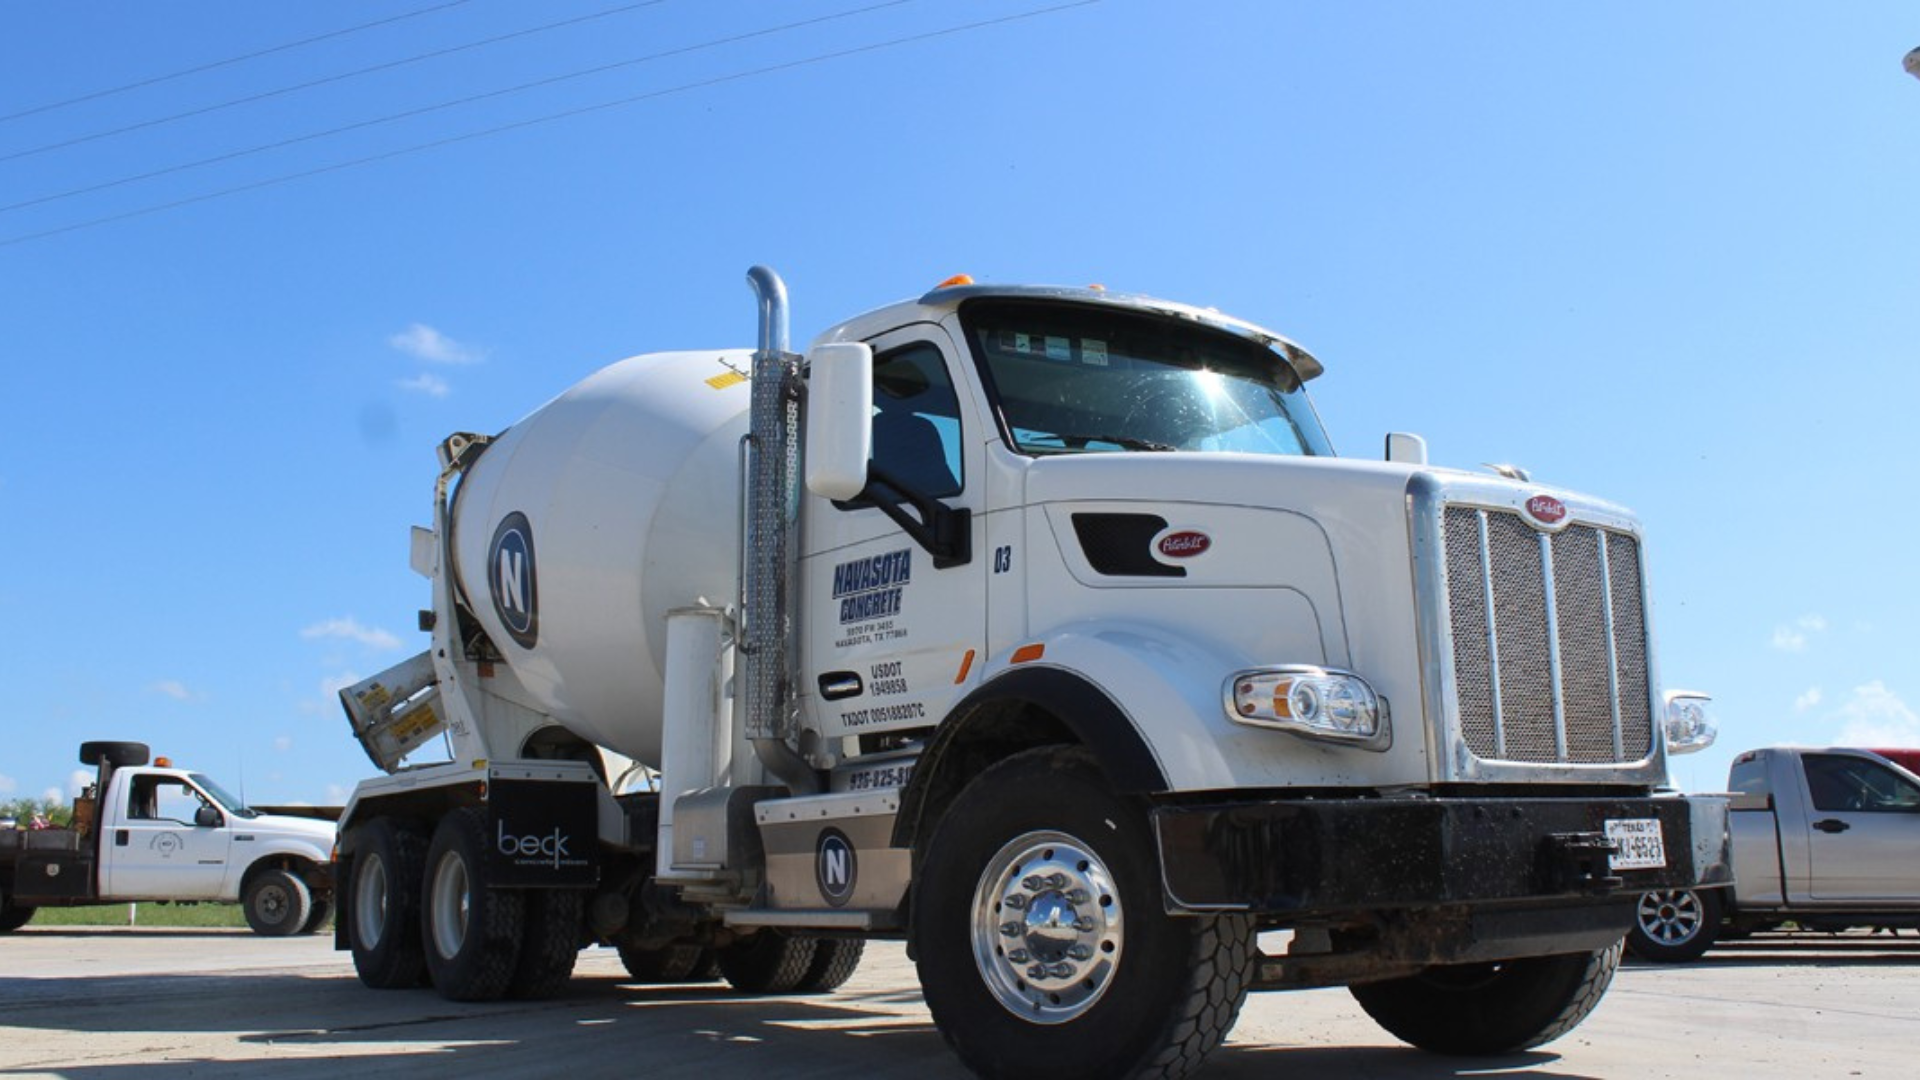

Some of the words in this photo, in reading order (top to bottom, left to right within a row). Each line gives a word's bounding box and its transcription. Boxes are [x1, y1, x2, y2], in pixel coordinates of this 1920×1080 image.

[832, 548, 912, 598] NAVASOTA
[994, 546, 1011, 574] 03
[502, 548, 524, 613] N
[840, 588, 903, 623] CONCRETE
[874, 633, 884, 641] TX
[871, 661, 902, 679] USDOT
[841, 710, 870, 727] TXDOT
[1622, 823, 1644, 832] TEXAS
[498, 819, 569, 870] beck
[826, 849, 845, 885] N
